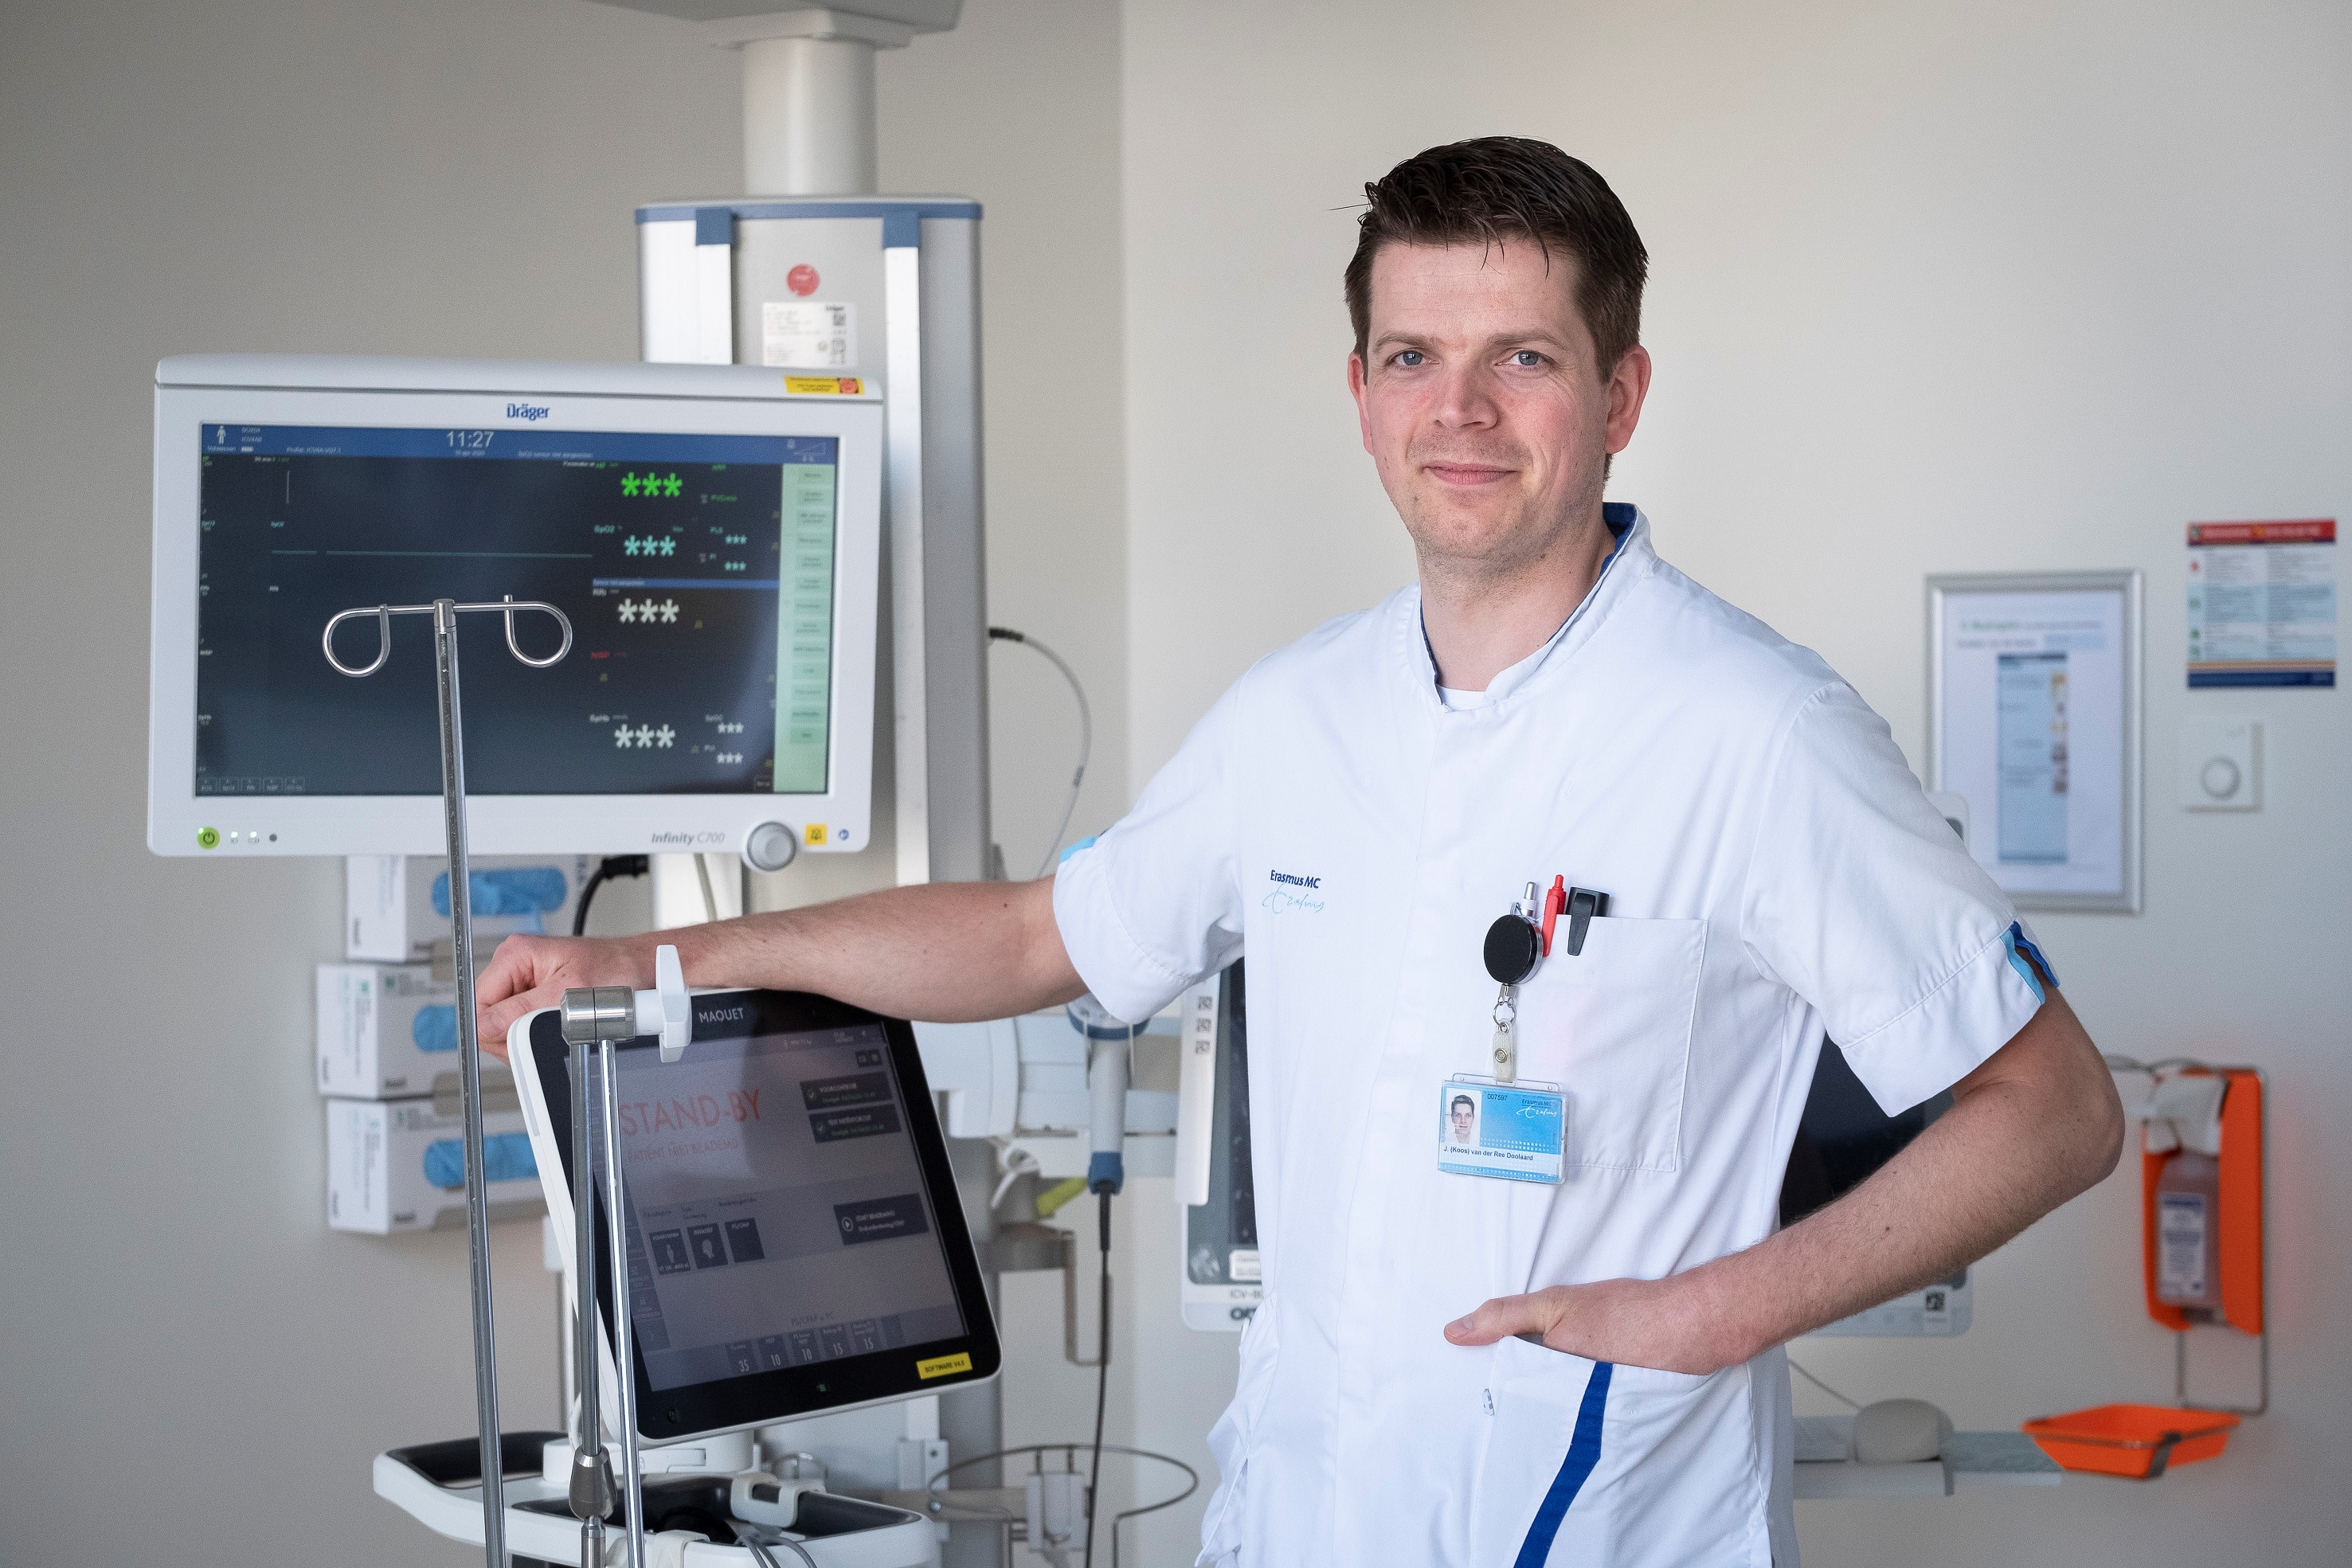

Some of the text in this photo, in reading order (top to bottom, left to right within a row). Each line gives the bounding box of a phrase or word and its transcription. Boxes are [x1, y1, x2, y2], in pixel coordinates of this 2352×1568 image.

[507, 403, 550, 420] Dräger
[446, 431, 495, 448] 11:27
[652, 831, 726, 846] Infinity C700
[1270, 869, 1321, 889] Erasmus MC
[699, 1007, 744, 1023] MAQUET
[1487, 1093, 1509, 1101] 007597
[618, 1088, 761, 1138] STAND-BY
[1450, 1146, 1470, 1155] (Koos)
[1506, 1152, 1533, 1161] Doolaard
[863, 1337, 875, 1351] 15
[770, 1353, 781, 1367] 10
[801, 1348, 812, 1362] 10
[738, 1359, 749, 1372] 35
